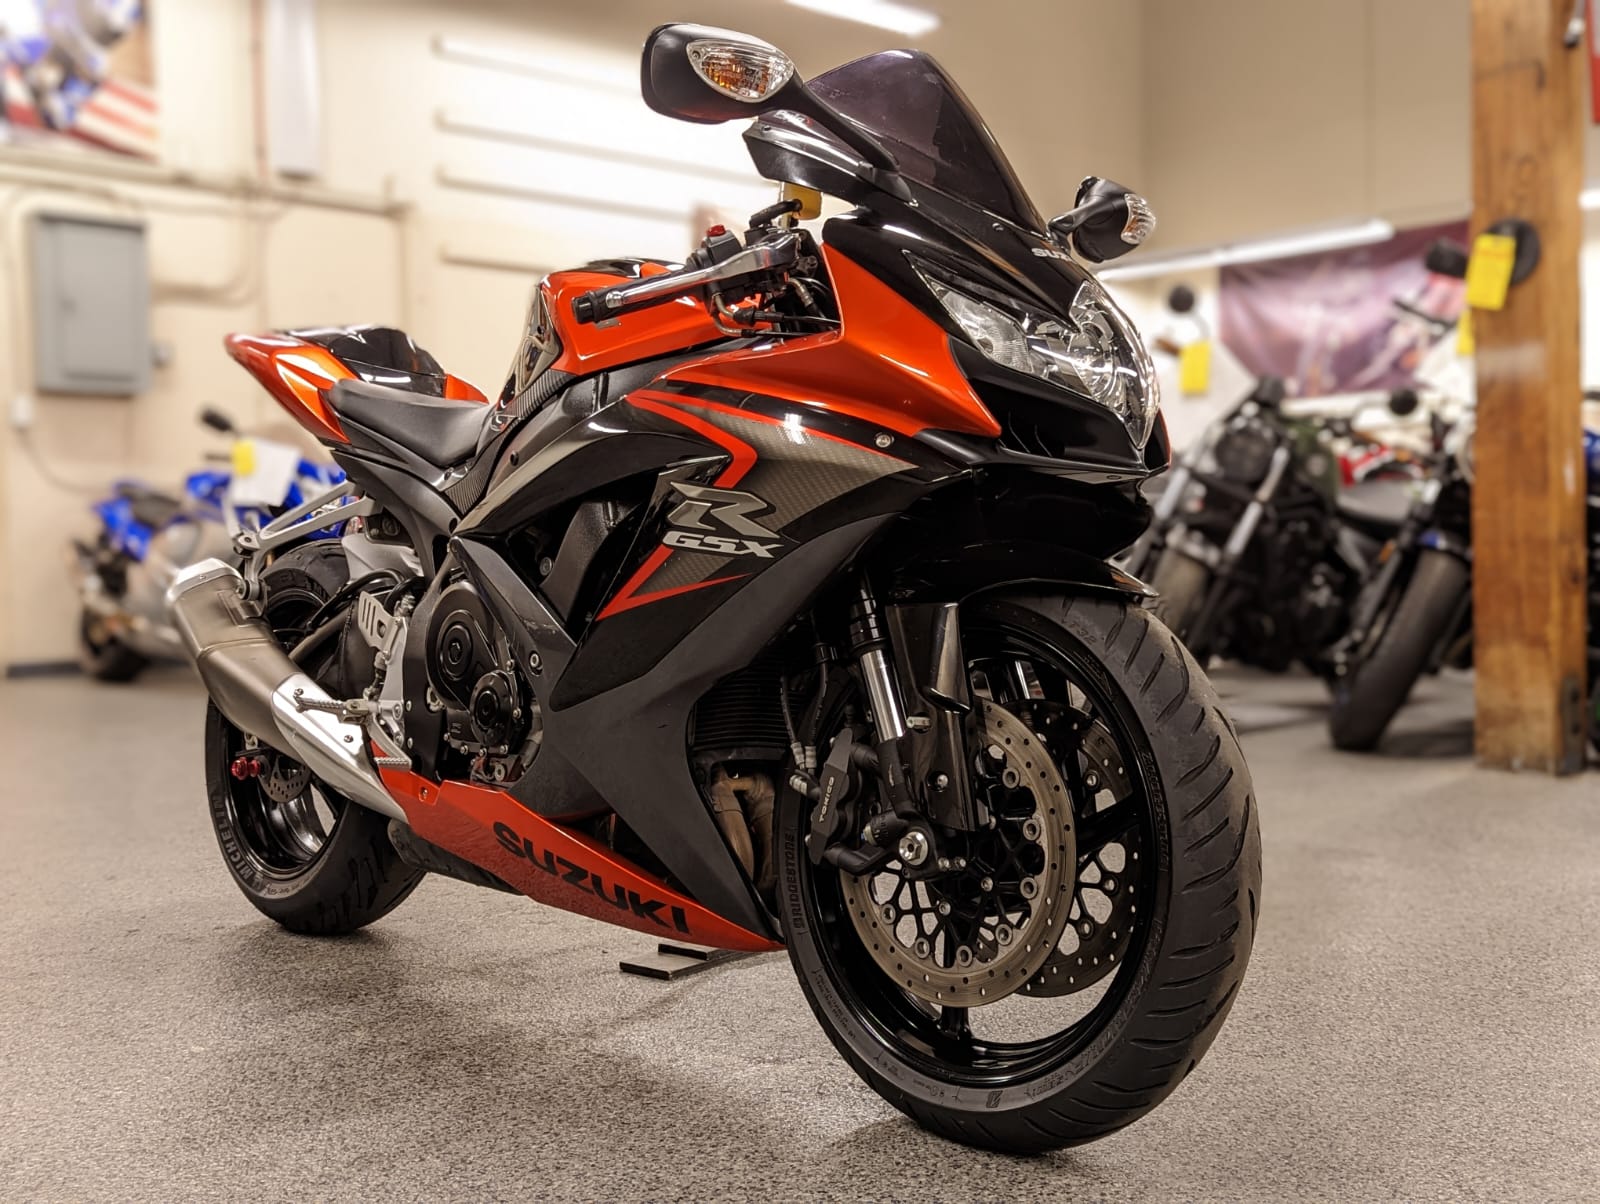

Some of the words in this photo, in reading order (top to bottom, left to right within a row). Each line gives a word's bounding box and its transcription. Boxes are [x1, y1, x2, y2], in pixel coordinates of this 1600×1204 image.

[662, 530, 785, 559] GSX
[819, 776, 835, 823] TOKICO
[493, 821, 690, 934] SUZUKI
